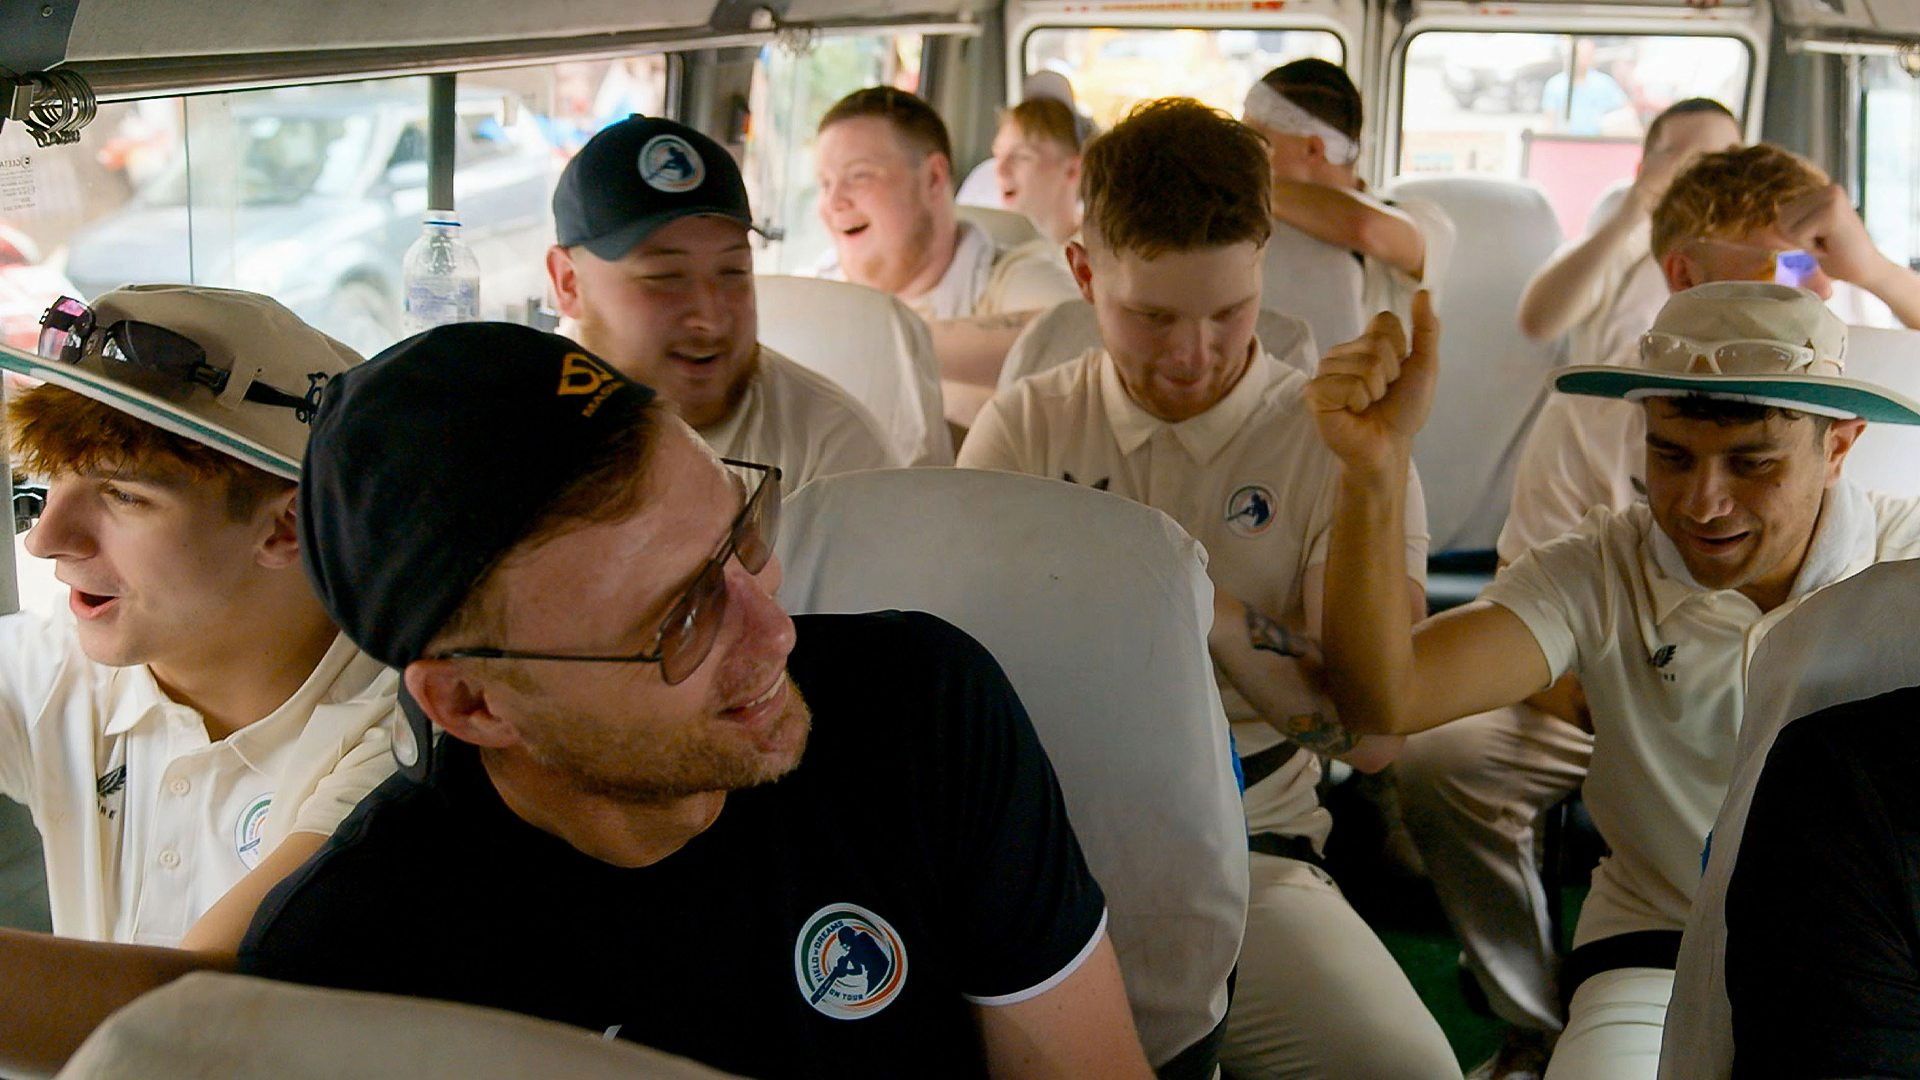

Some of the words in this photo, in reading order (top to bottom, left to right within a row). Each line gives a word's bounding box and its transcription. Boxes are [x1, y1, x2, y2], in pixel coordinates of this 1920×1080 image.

[814, 920, 844, 949] DREAMS
[811, 956, 824, 983] FIELD
[829, 989, 841, 998] ON
